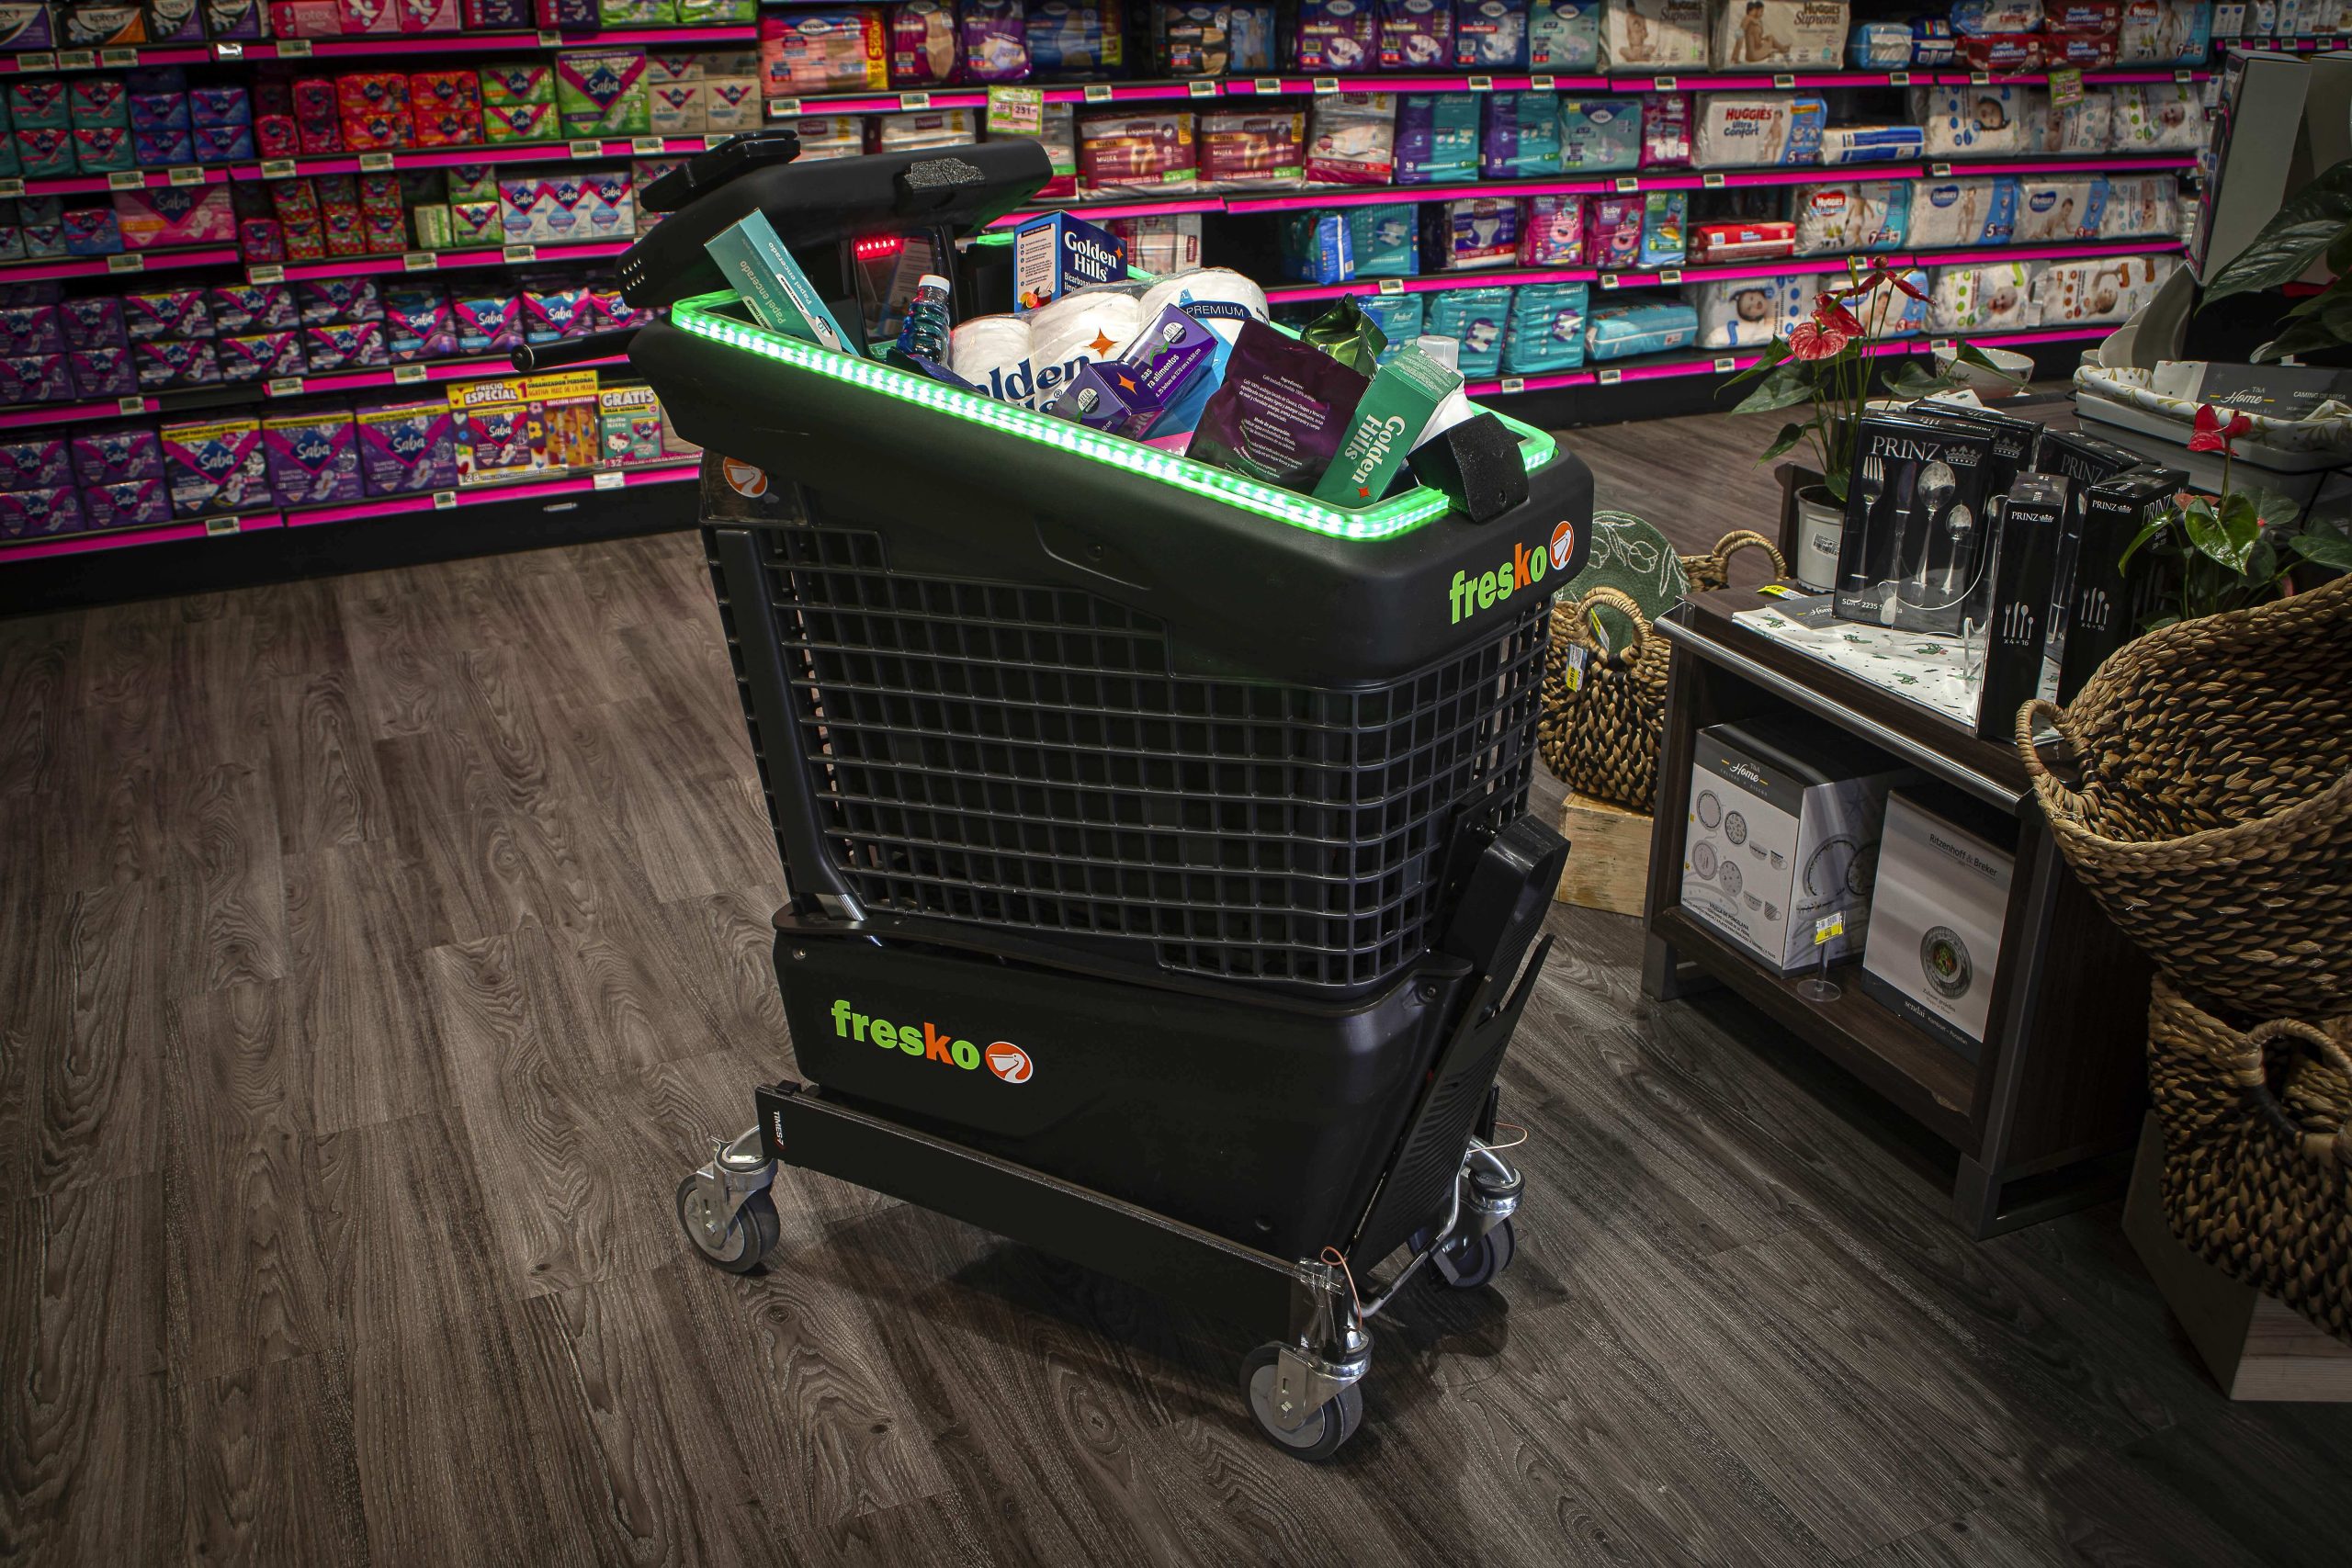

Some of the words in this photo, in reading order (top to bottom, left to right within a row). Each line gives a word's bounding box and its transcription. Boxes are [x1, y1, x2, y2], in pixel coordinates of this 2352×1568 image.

[1660, 8, 1702, 22] Supreme
[1804, 3, 1840, 14] HUGGIES
[1793, 12, 1839, 28] Supreme
[588, 76, 619, 95] Saba
[1725, 107, 1772, 121] HUGGIES
[1732, 120, 1752, 129] Ultra
[1724, 127, 1758, 138] Confort
[1787, 151, 1795, 163] 5
[514, 193, 534, 205] Saba
[559, 189, 579, 201] Saba
[601, 186, 621, 198] Saba
[157, 195, 190, 211] Saba
[1602, 207, 1621, 215] Baby
[1986, 226, 1994, 236] 5
[1064, 231, 1117, 269] Golden
[766, 241, 797, 281] encerado
[1074, 253, 1107, 282] Hills
[737, 258, 770, 302] encerado
[793, 279, 813, 305] Papel
[478, 310, 503, 324] Saba
[548, 307, 572, 321] Saba
[765, 298, 787, 325] Papel
[1186, 304, 1245, 317] PREMIUM
[409, 313, 435, 327] Saba
[815, 321, 827, 333] 10
[1150, 352, 1181, 382] alimentos
[475, 382, 503, 392] PRECIO
[2293, 390, 2318, 399] CAMINO
[465, 389, 517, 404] ESPECIAL
[602, 389, 654, 407] GRATIS
[1078, 389, 1091, 403] SELLO
[2221, 389, 2263, 405] Home
[489, 425, 512, 437] Saba
[1344, 414, 1384, 460] Hills
[297, 441, 331, 459] Saba
[393, 436, 425, 455] Saba
[1352, 415, 1406, 484] Golden
[1871, 435, 1941, 462] PRINZ
[199, 451, 234, 468] Saba
[2061, 454, 2103, 484] PRINZ
[466, 473, 480, 482] 28
[2092, 500, 2117, 512] PRINZ
[2011, 511, 2039, 522] PRINZ
[1449, 542, 1547, 625] fresko
[1861, 602, 1878, 610] 2235
[1729, 761, 1760, 784] Home
[1929, 833, 1967, 860] Ritzenhoff
[1966, 854, 1973, 863] &
[1973, 858, 1998, 877] Breker
[1903, 998, 1927, 1018] sendai
[831, 999, 980, 1071] fresko
